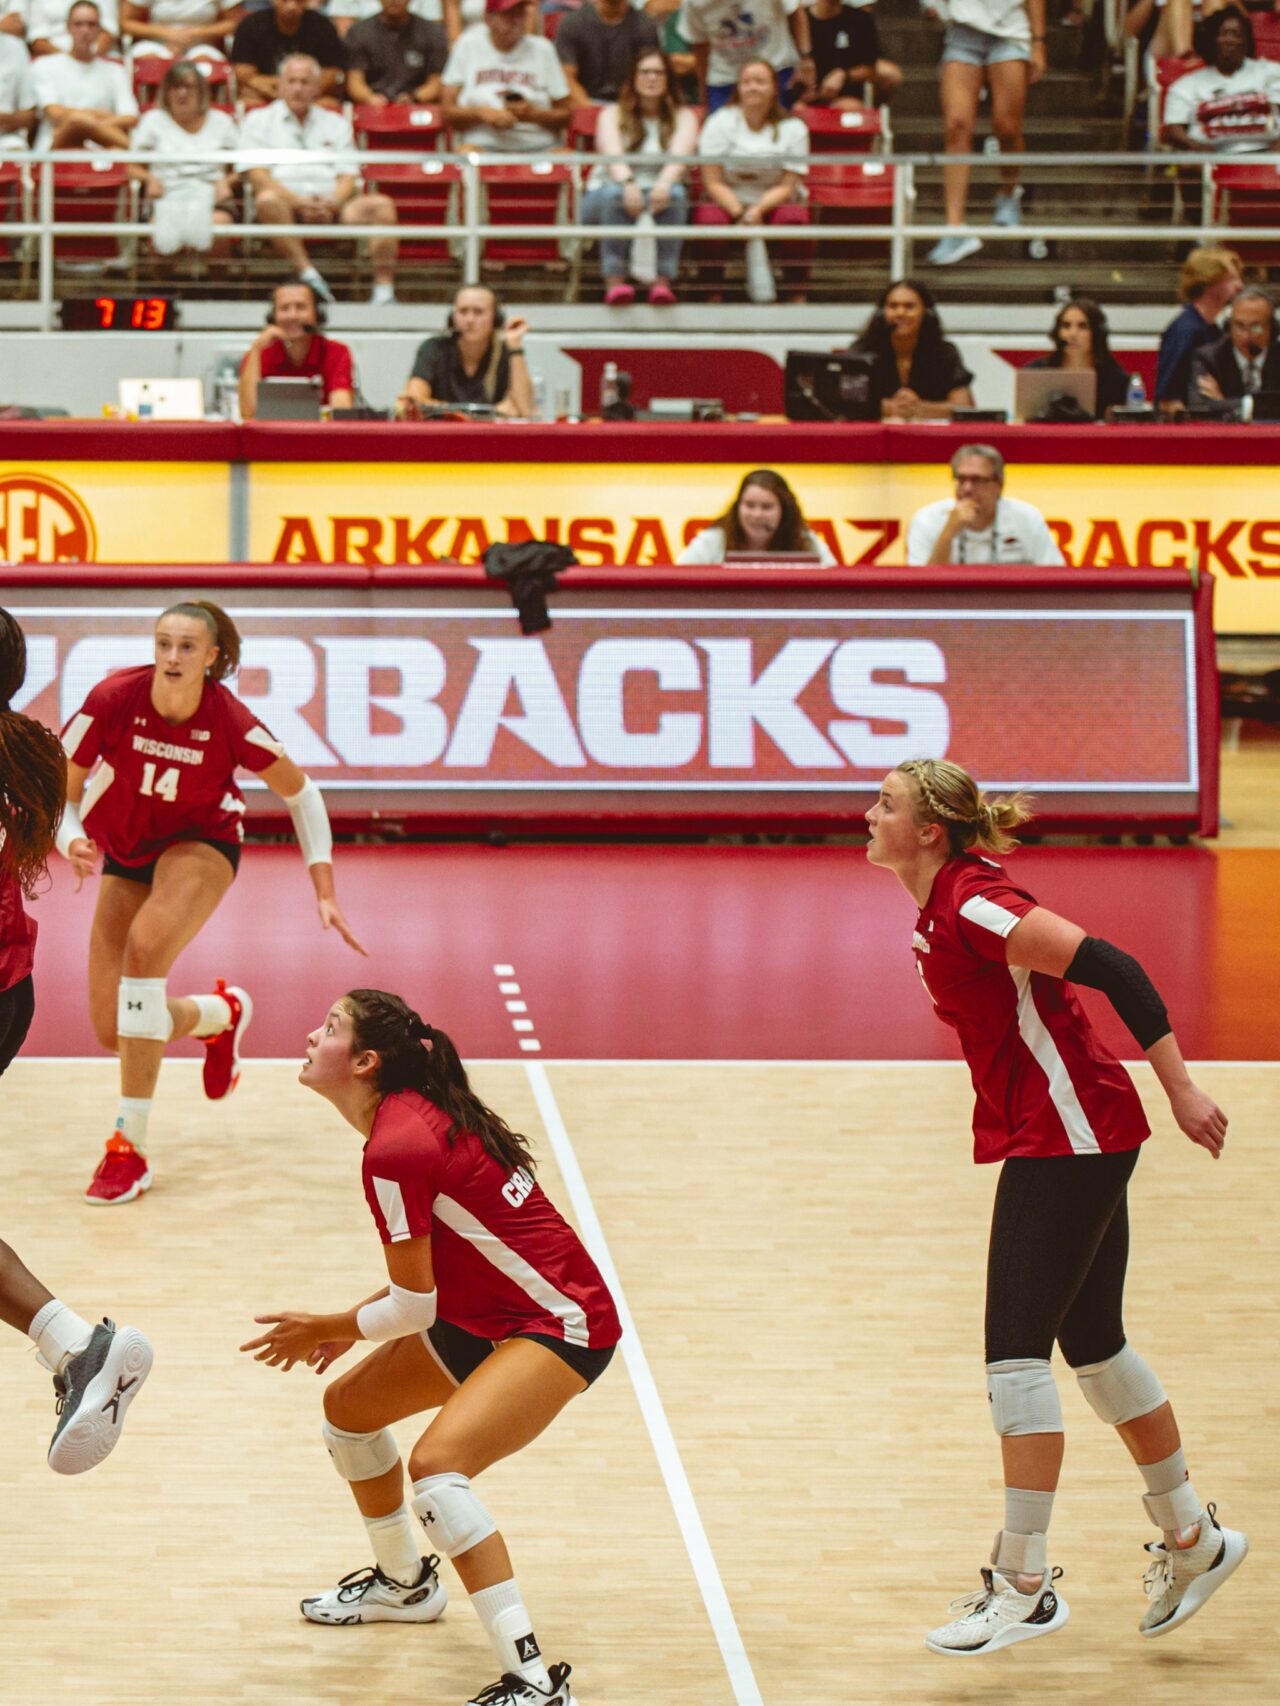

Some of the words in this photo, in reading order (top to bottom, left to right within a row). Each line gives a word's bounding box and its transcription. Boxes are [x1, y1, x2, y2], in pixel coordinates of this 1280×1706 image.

[96, 297, 115, 329] 7
[131, 297, 167, 330] 13
[132, 734, 205, 766] WISCONSIN
[139, 762, 181, 802] 14
